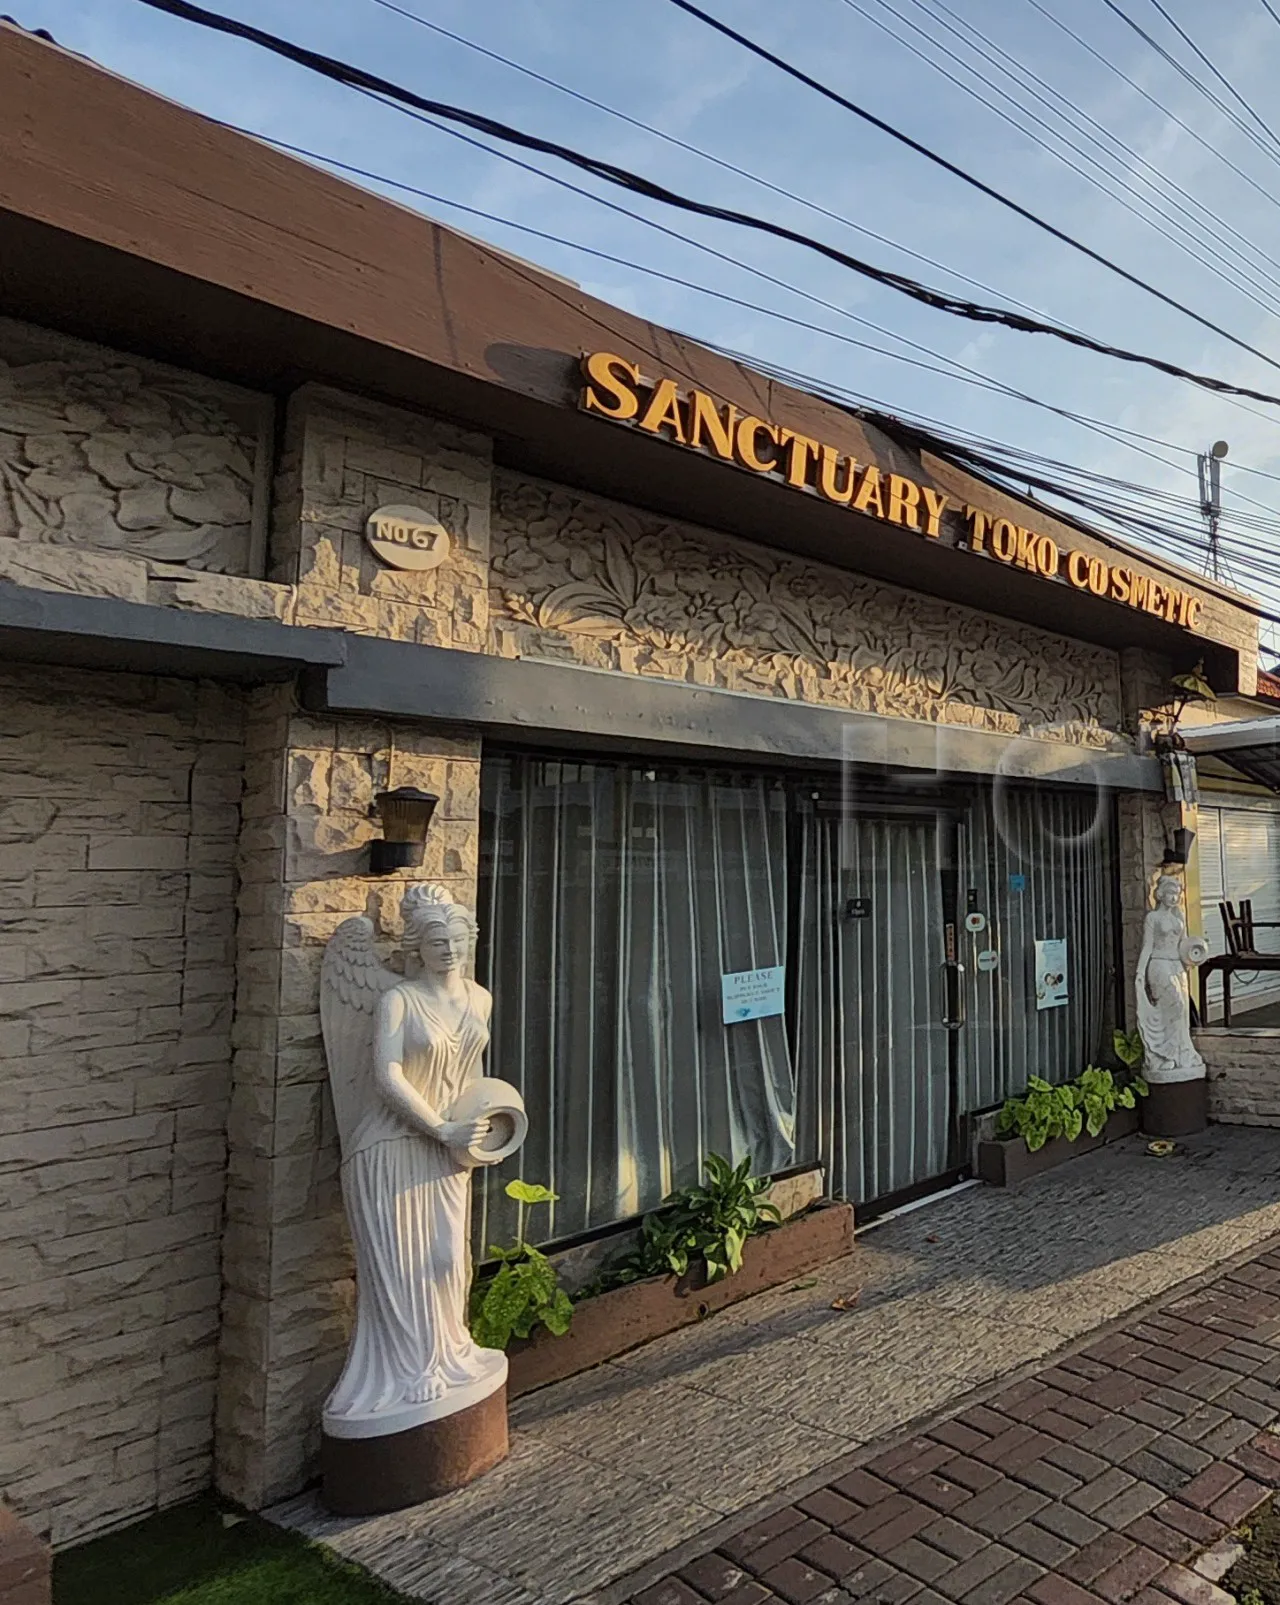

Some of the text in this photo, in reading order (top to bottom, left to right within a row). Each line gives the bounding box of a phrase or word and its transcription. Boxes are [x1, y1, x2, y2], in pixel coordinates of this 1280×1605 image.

[583, 351, 1204, 629] SANCTUARY TOKO COSMETIC
[734, 971, 773, 985] PLEASE
